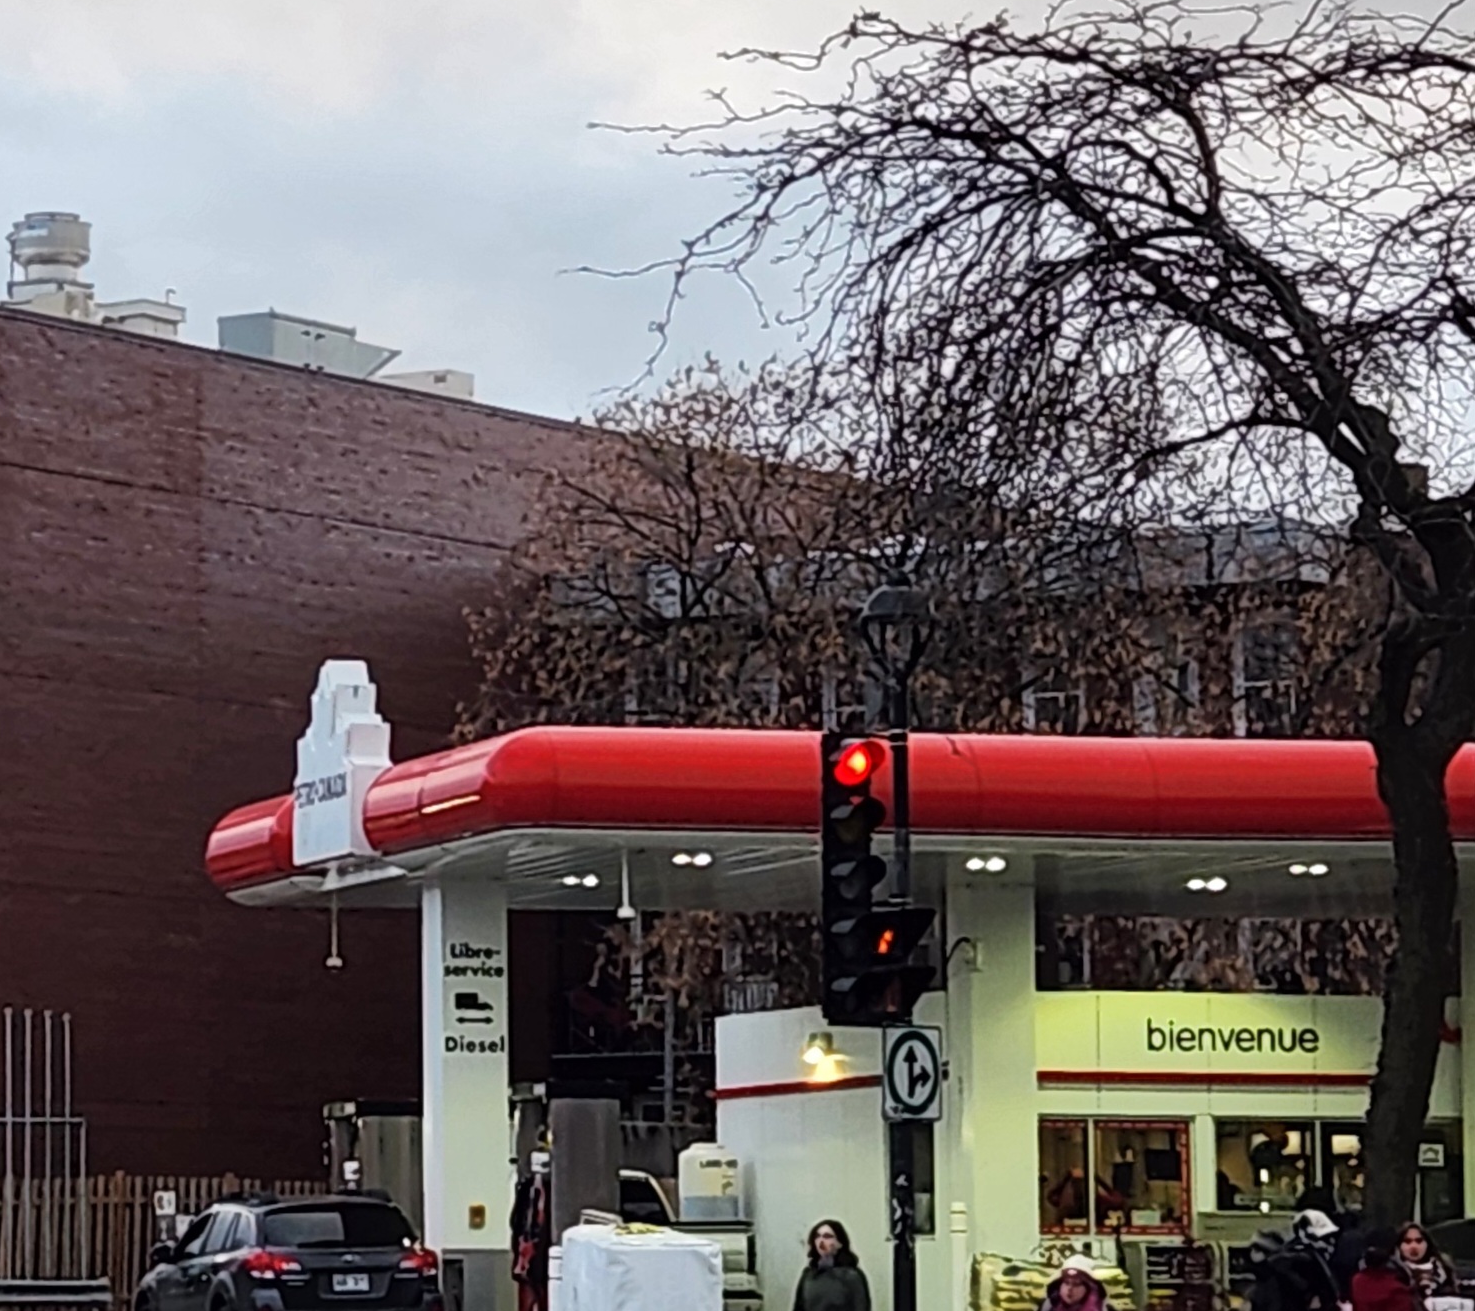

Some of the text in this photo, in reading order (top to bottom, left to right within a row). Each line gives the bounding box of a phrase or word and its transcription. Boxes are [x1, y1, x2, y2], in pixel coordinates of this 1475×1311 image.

[450, 942, 501, 959] Libre-
[444, 960, 504, 978] service
[445, 1035, 505, 1053] Diesel
[1146, 1017, 1320, 1053] bienvenue
